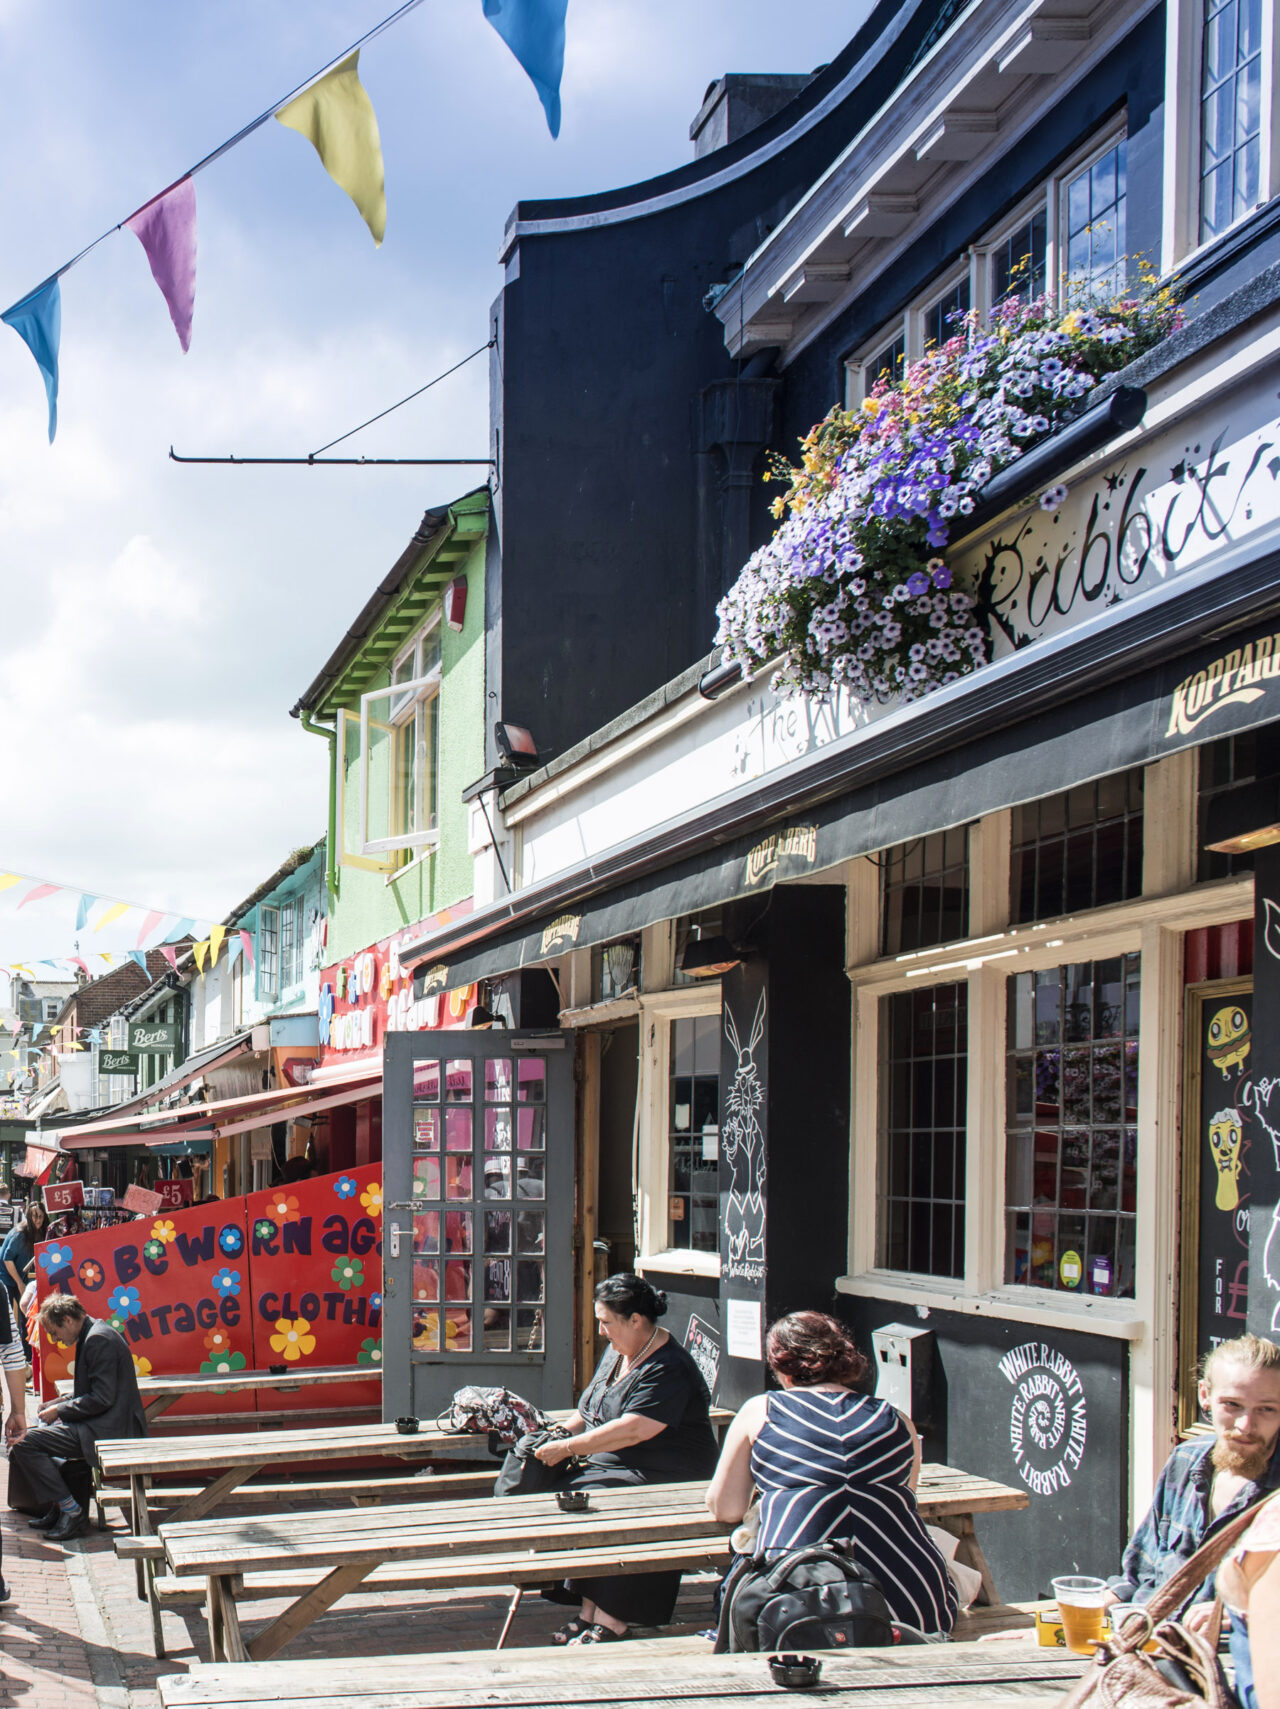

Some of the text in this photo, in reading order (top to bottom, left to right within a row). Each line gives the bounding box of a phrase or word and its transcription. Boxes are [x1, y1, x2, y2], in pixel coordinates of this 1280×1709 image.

[972, 425, 1273, 664] Rabbit
[54, 1190, 71, 1206] £5
[162, 1184, 182, 1205] £5
[48, 1258, 106, 1296] TO
[174, 1216, 313, 1267] WORN
[998, 1342, 1038, 1384] WHITE
[1019, 1374, 1060, 1404] RABBIT
[1040, 1343, 1083, 1396] RABBIT
[1010, 1395, 1026, 1464] WHITE
[1049, 1392, 1065, 1449] WHITE
[1064, 1397, 1087, 1470] WHITE
[1020, 1460, 1071, 1495] RABBIT
